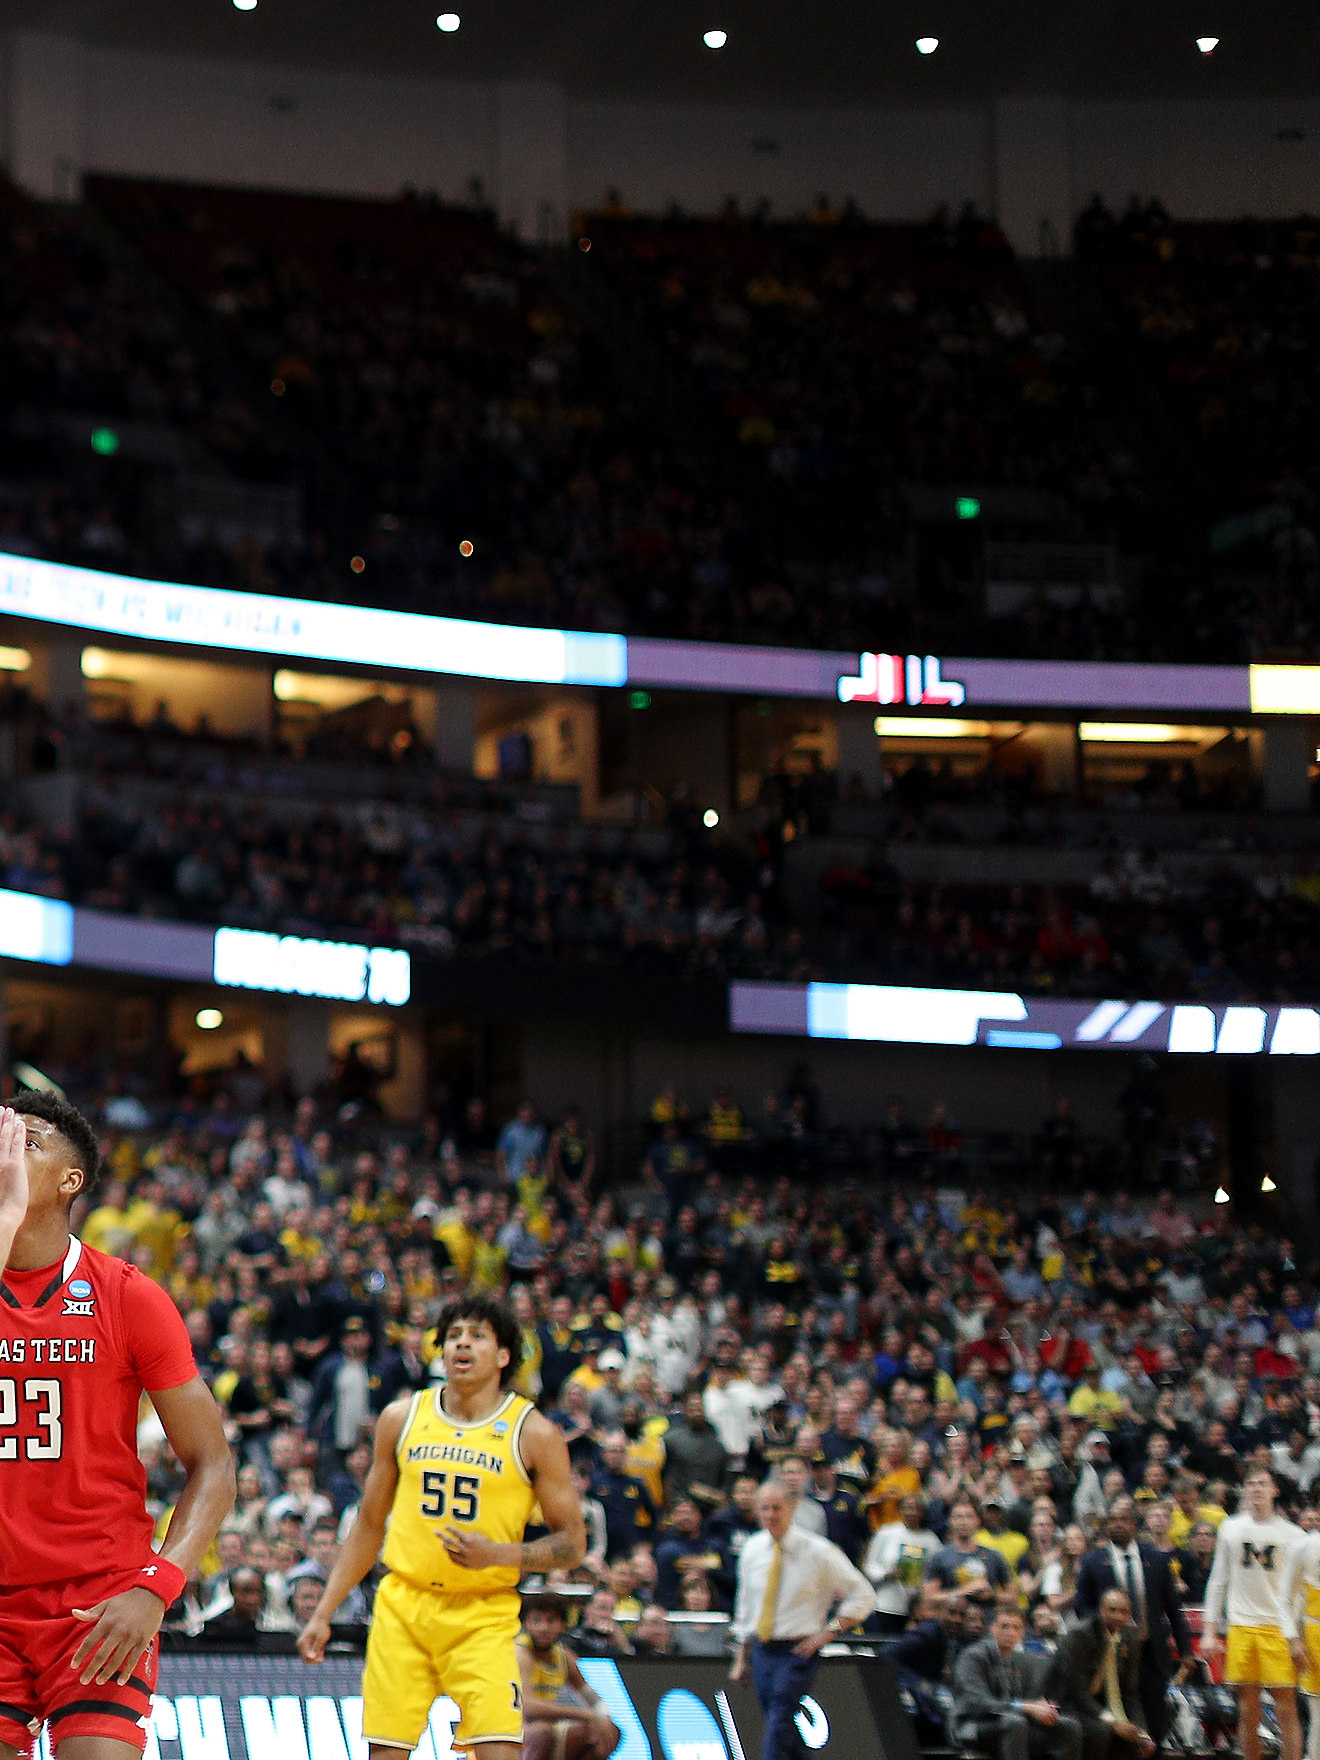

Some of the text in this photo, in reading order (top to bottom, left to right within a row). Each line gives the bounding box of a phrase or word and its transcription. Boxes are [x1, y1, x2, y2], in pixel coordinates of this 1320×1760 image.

[30, 1339, 96, 1363] TECH
[407, 1446, 503, 1473] MICHIGAN
[421, 1470, 481, 1522] 55
[1241, 1541, 1276, 1570] M
